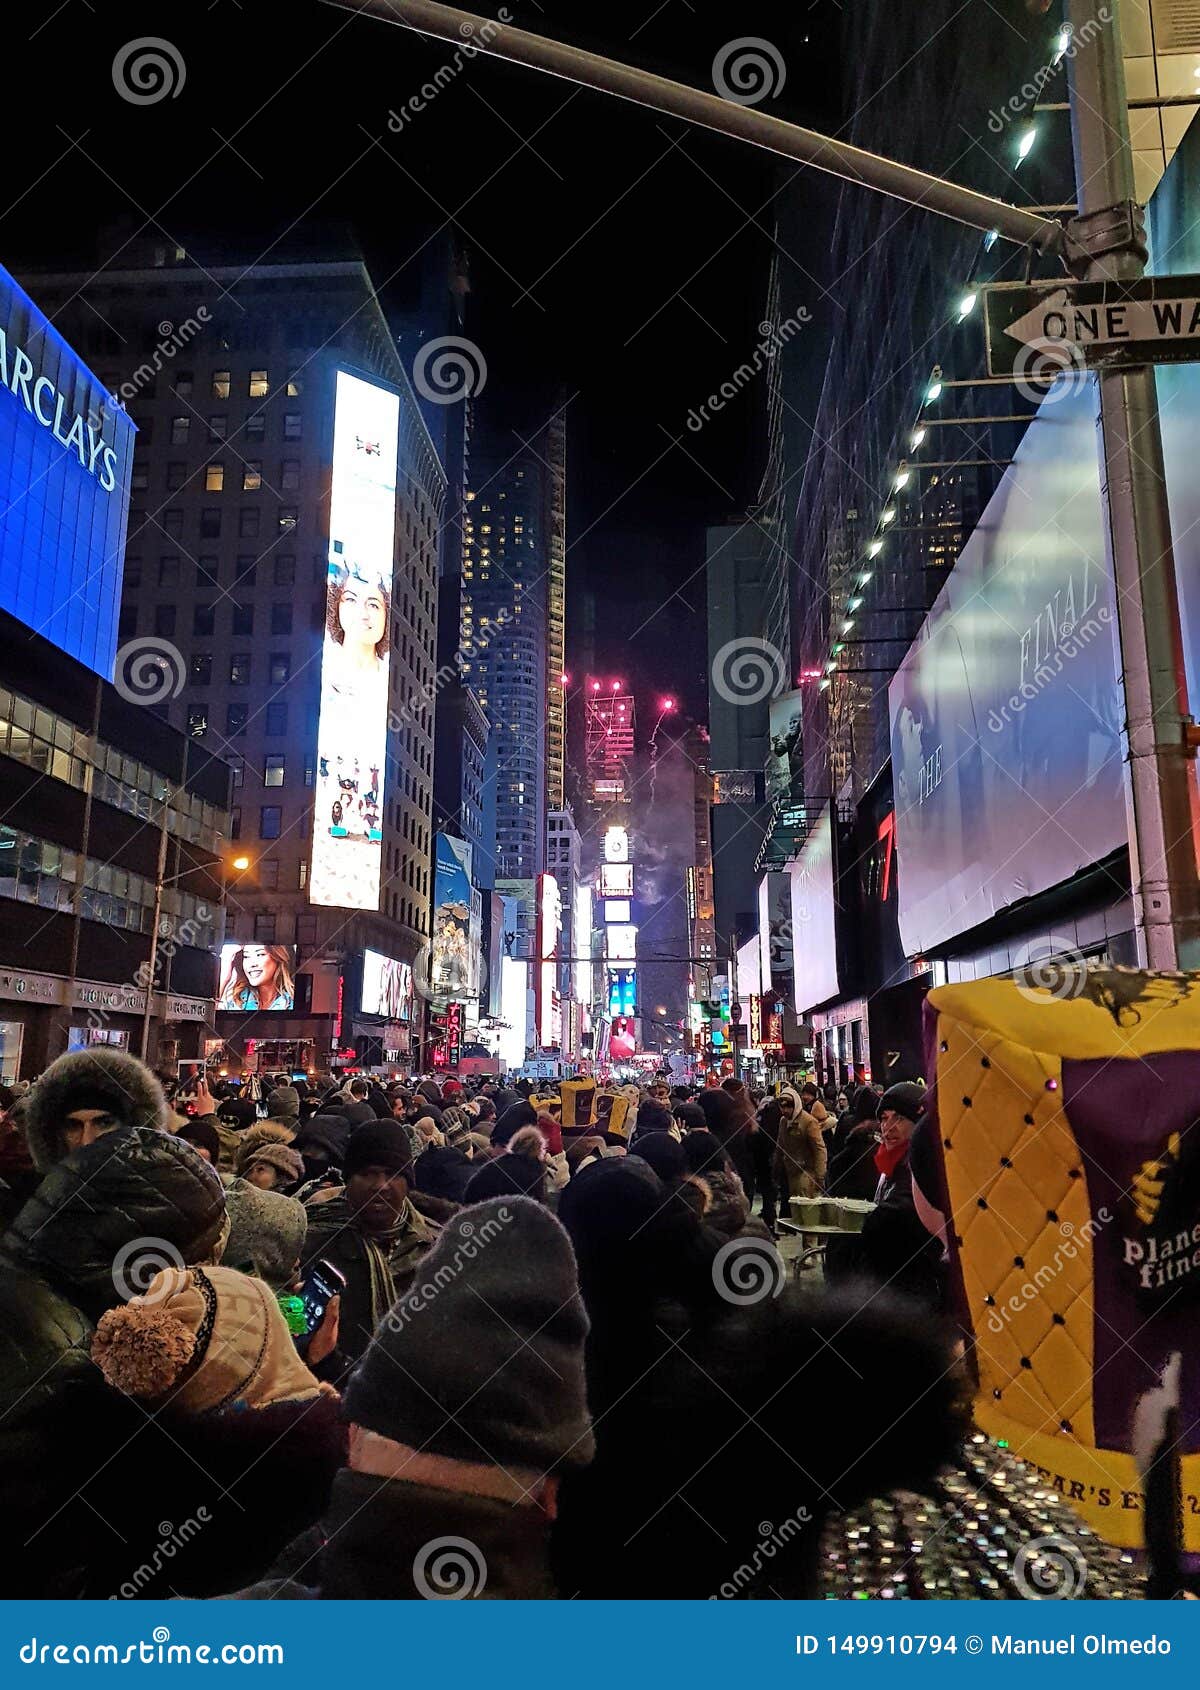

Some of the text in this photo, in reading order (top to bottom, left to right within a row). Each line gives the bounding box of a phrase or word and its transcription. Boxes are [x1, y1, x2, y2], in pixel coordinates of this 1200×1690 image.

[1043, 306, 1130, 342] ONE
[918, 558, 1098, 805] THE FINAL
